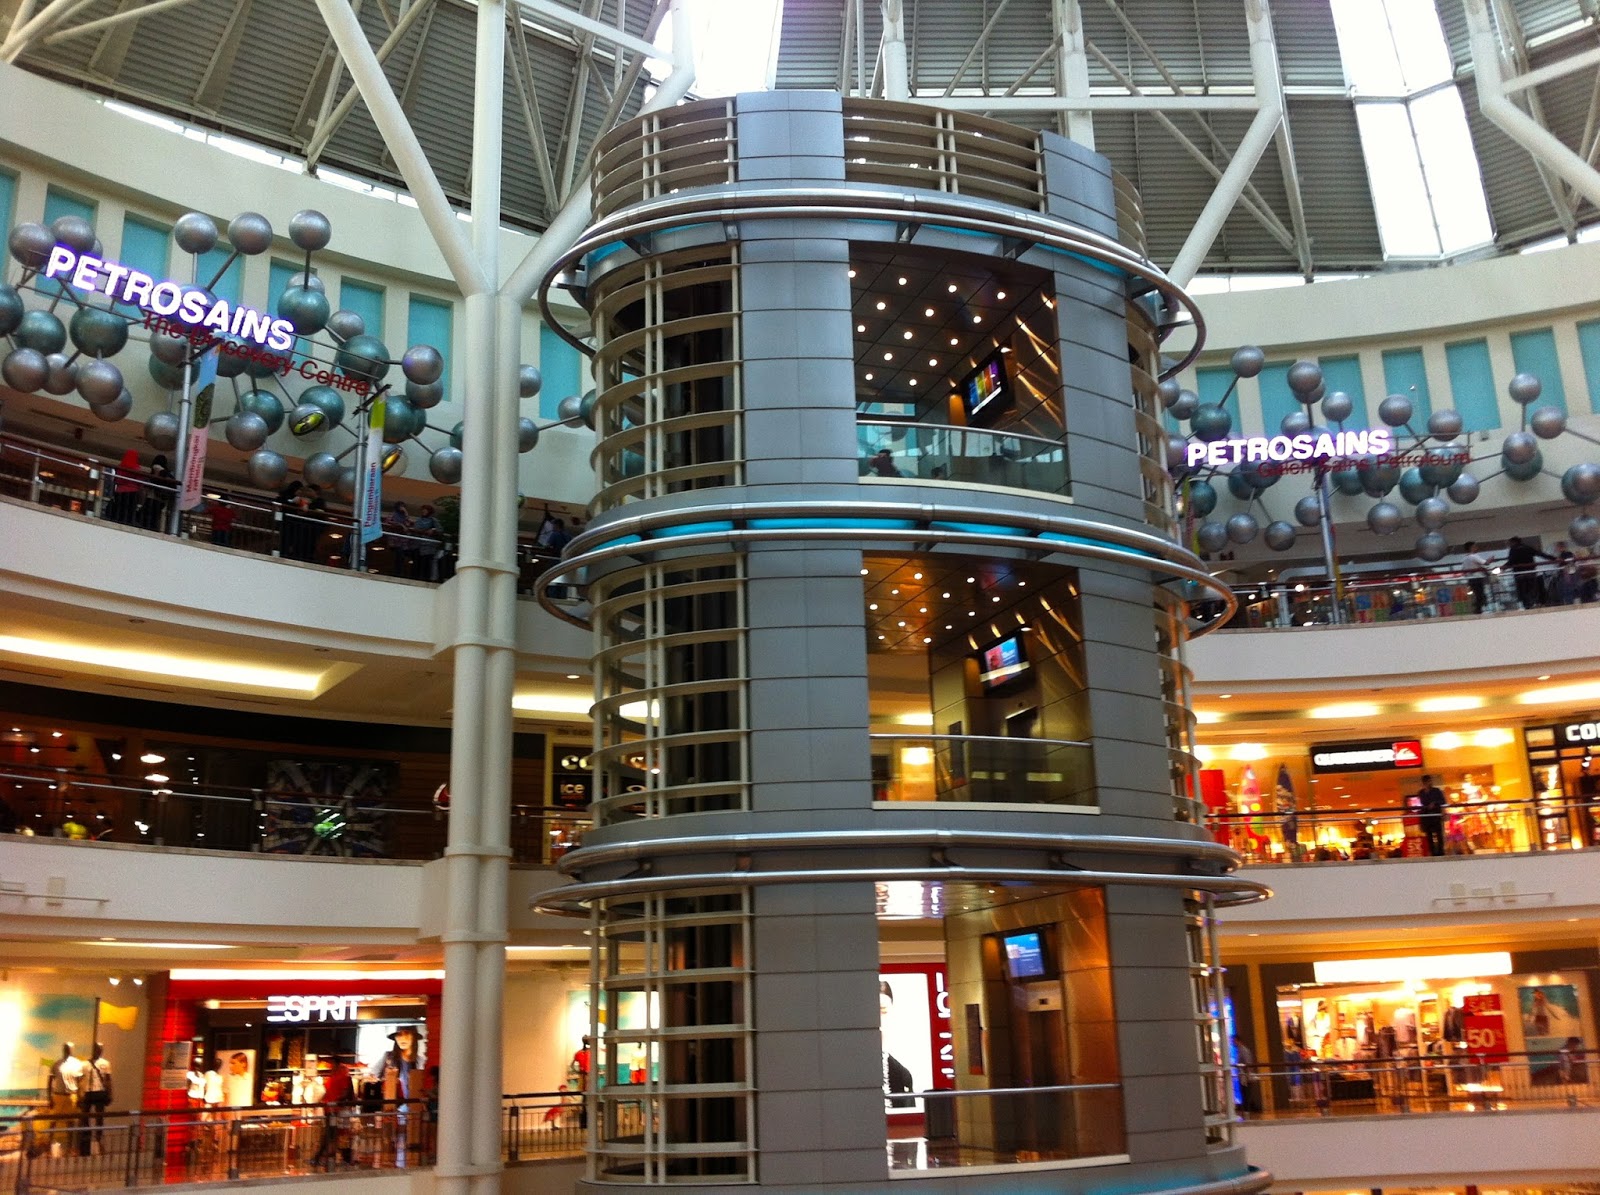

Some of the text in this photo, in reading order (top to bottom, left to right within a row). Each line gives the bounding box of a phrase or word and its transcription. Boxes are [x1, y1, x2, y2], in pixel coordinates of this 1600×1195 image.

[45, 245, 296, 352] PETROSAINS
[143, 310, 182, 339] The
[300, 360, 370, 397] Centre
[1187, 430, 1391, 467] PETROSAINS
[1565, 722, 1600, 741] CO
[267, 995, 365, 1022] ESPRIT
